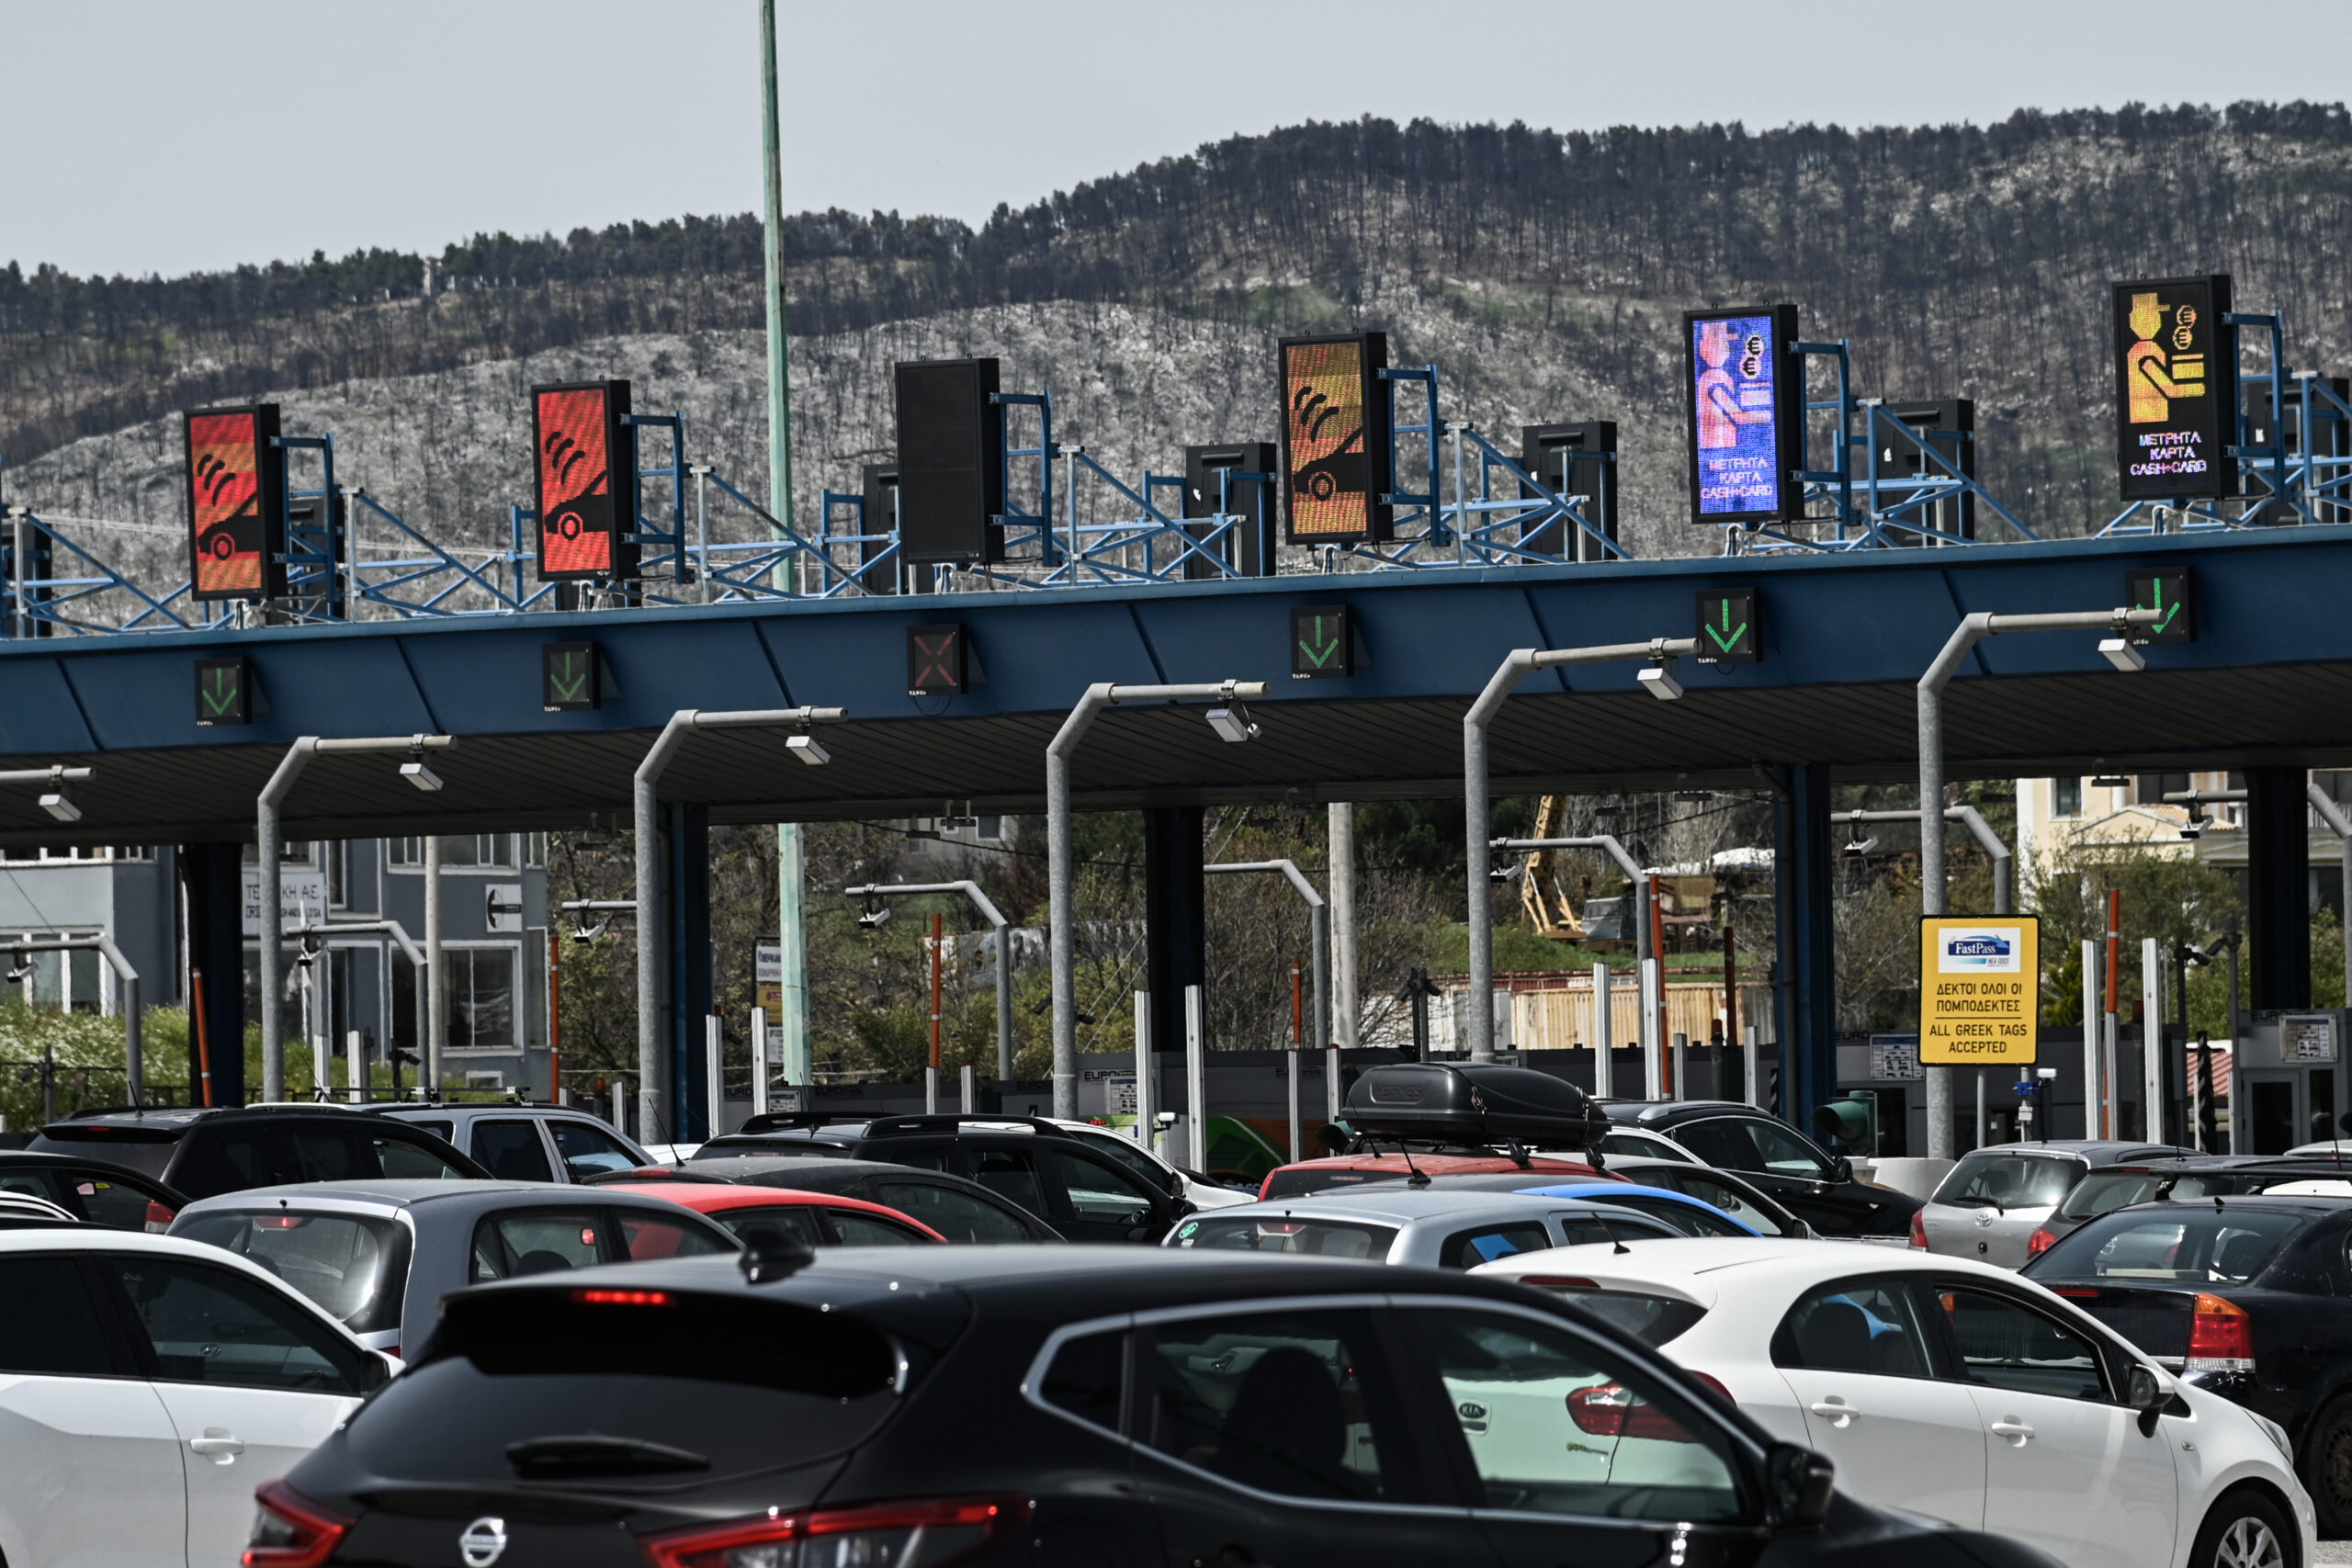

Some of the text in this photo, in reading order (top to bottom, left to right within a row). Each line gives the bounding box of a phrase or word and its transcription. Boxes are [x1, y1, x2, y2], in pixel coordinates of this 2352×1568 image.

[1955, 942, 1996, 954] FastPass
[1937, 983, 2022, 995] ΔΕΚΤΟΙ ΟΛΟΙ ΟΙ
[1937, 999, 2020, 1012] ΠΟΜΠΟΔΕΚΤΕΣ
[1929, 1024, 2028, 1036] ALL GREEK TAGS
[1949, 1041, 2007, 1054] ACCEPTED
[1461, 1404, 1482, 1416] KIA
